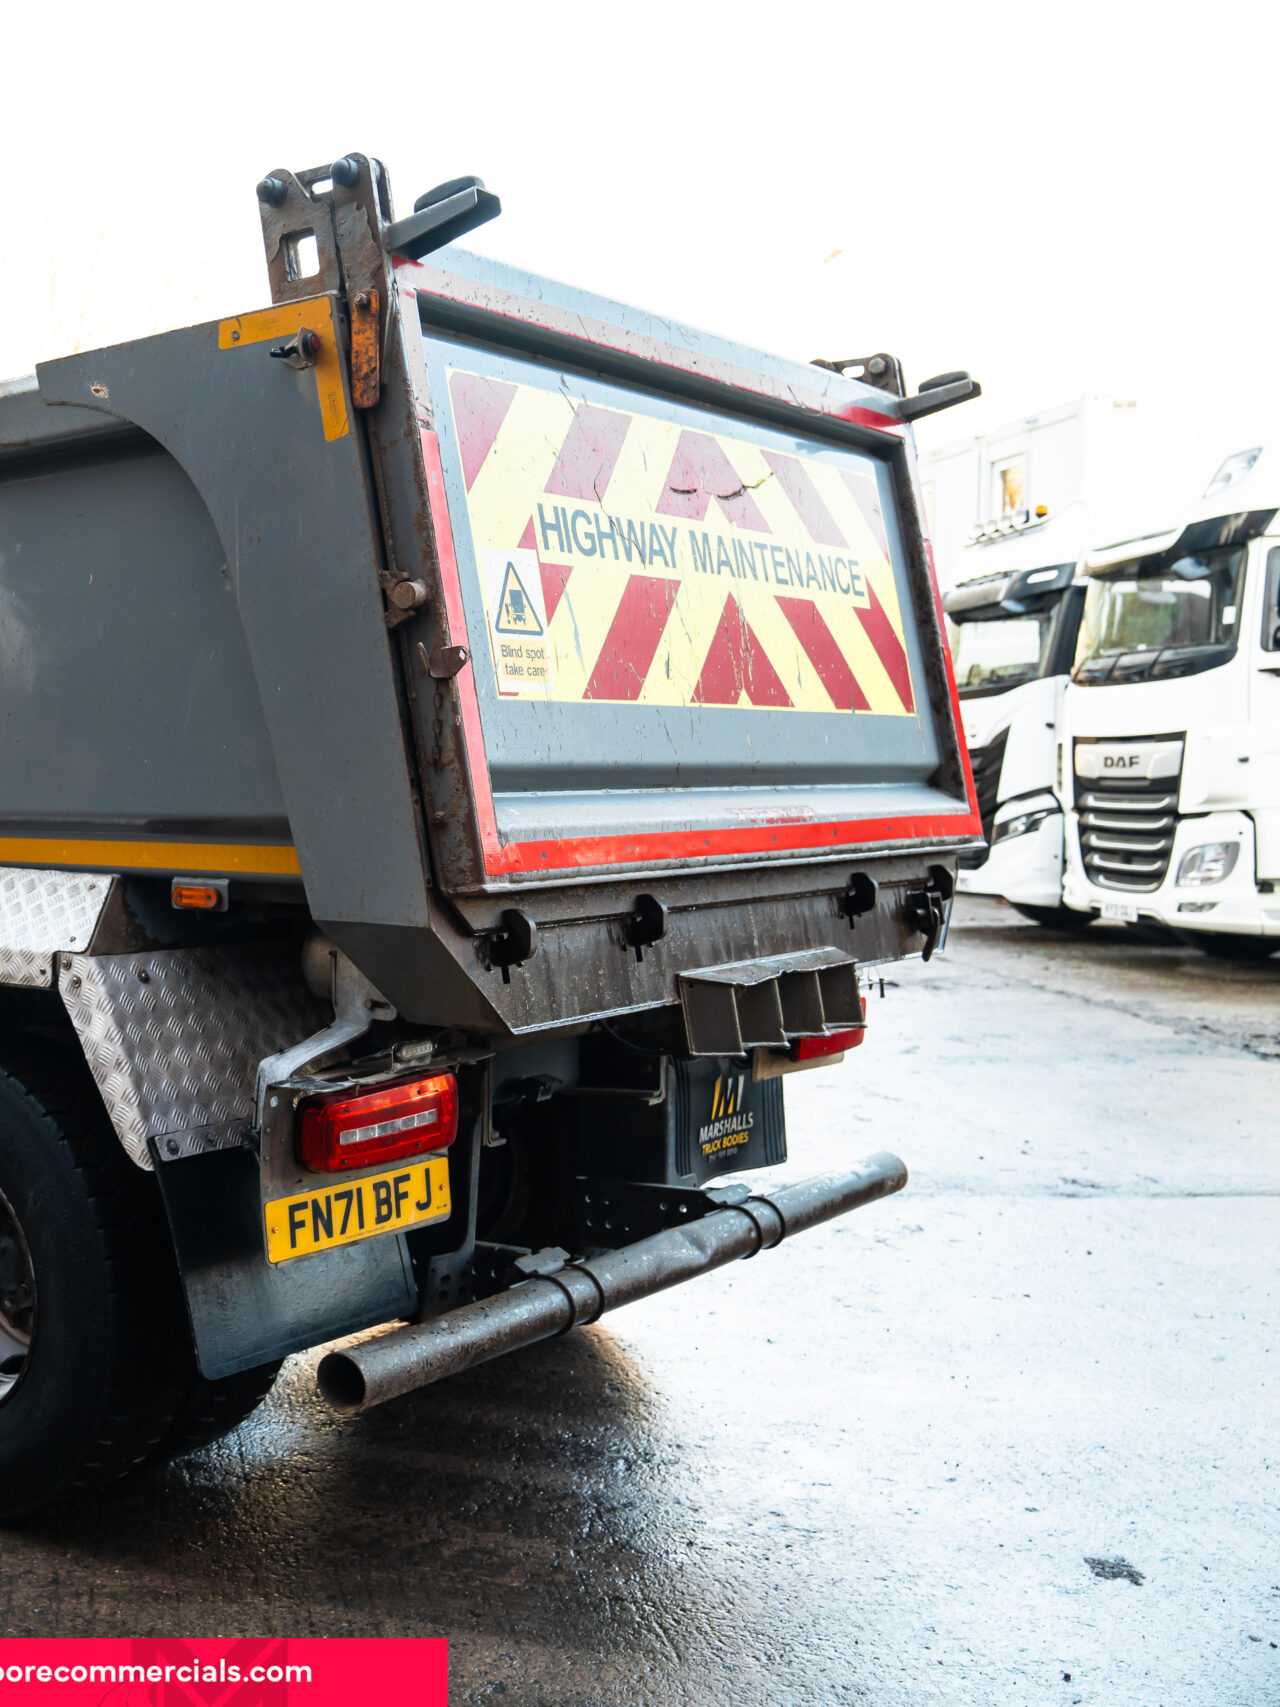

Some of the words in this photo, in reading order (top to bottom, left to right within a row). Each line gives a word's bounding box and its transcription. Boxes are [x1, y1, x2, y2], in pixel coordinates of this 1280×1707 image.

[537, 503, 677, 569] HIGHWAY
[689, 530, 865, 597] MAINTENANCE
[500, 644, 523, 658] Blind
[525, 648, 545, 662] spot
[505, 663, 524, 676] take
[526, 666, 546, 677] care
[1103, 755, 1140, 769] DAF
[699, 1112, 754, 1144] MARSHALLS
[702, 1139, 722, 1155] TRUCK
[723, 1131, 749, 1149] BODIES
[288, 1186, 365, 1249] FN71
[372, 1167, 432, 1226] BFJ
